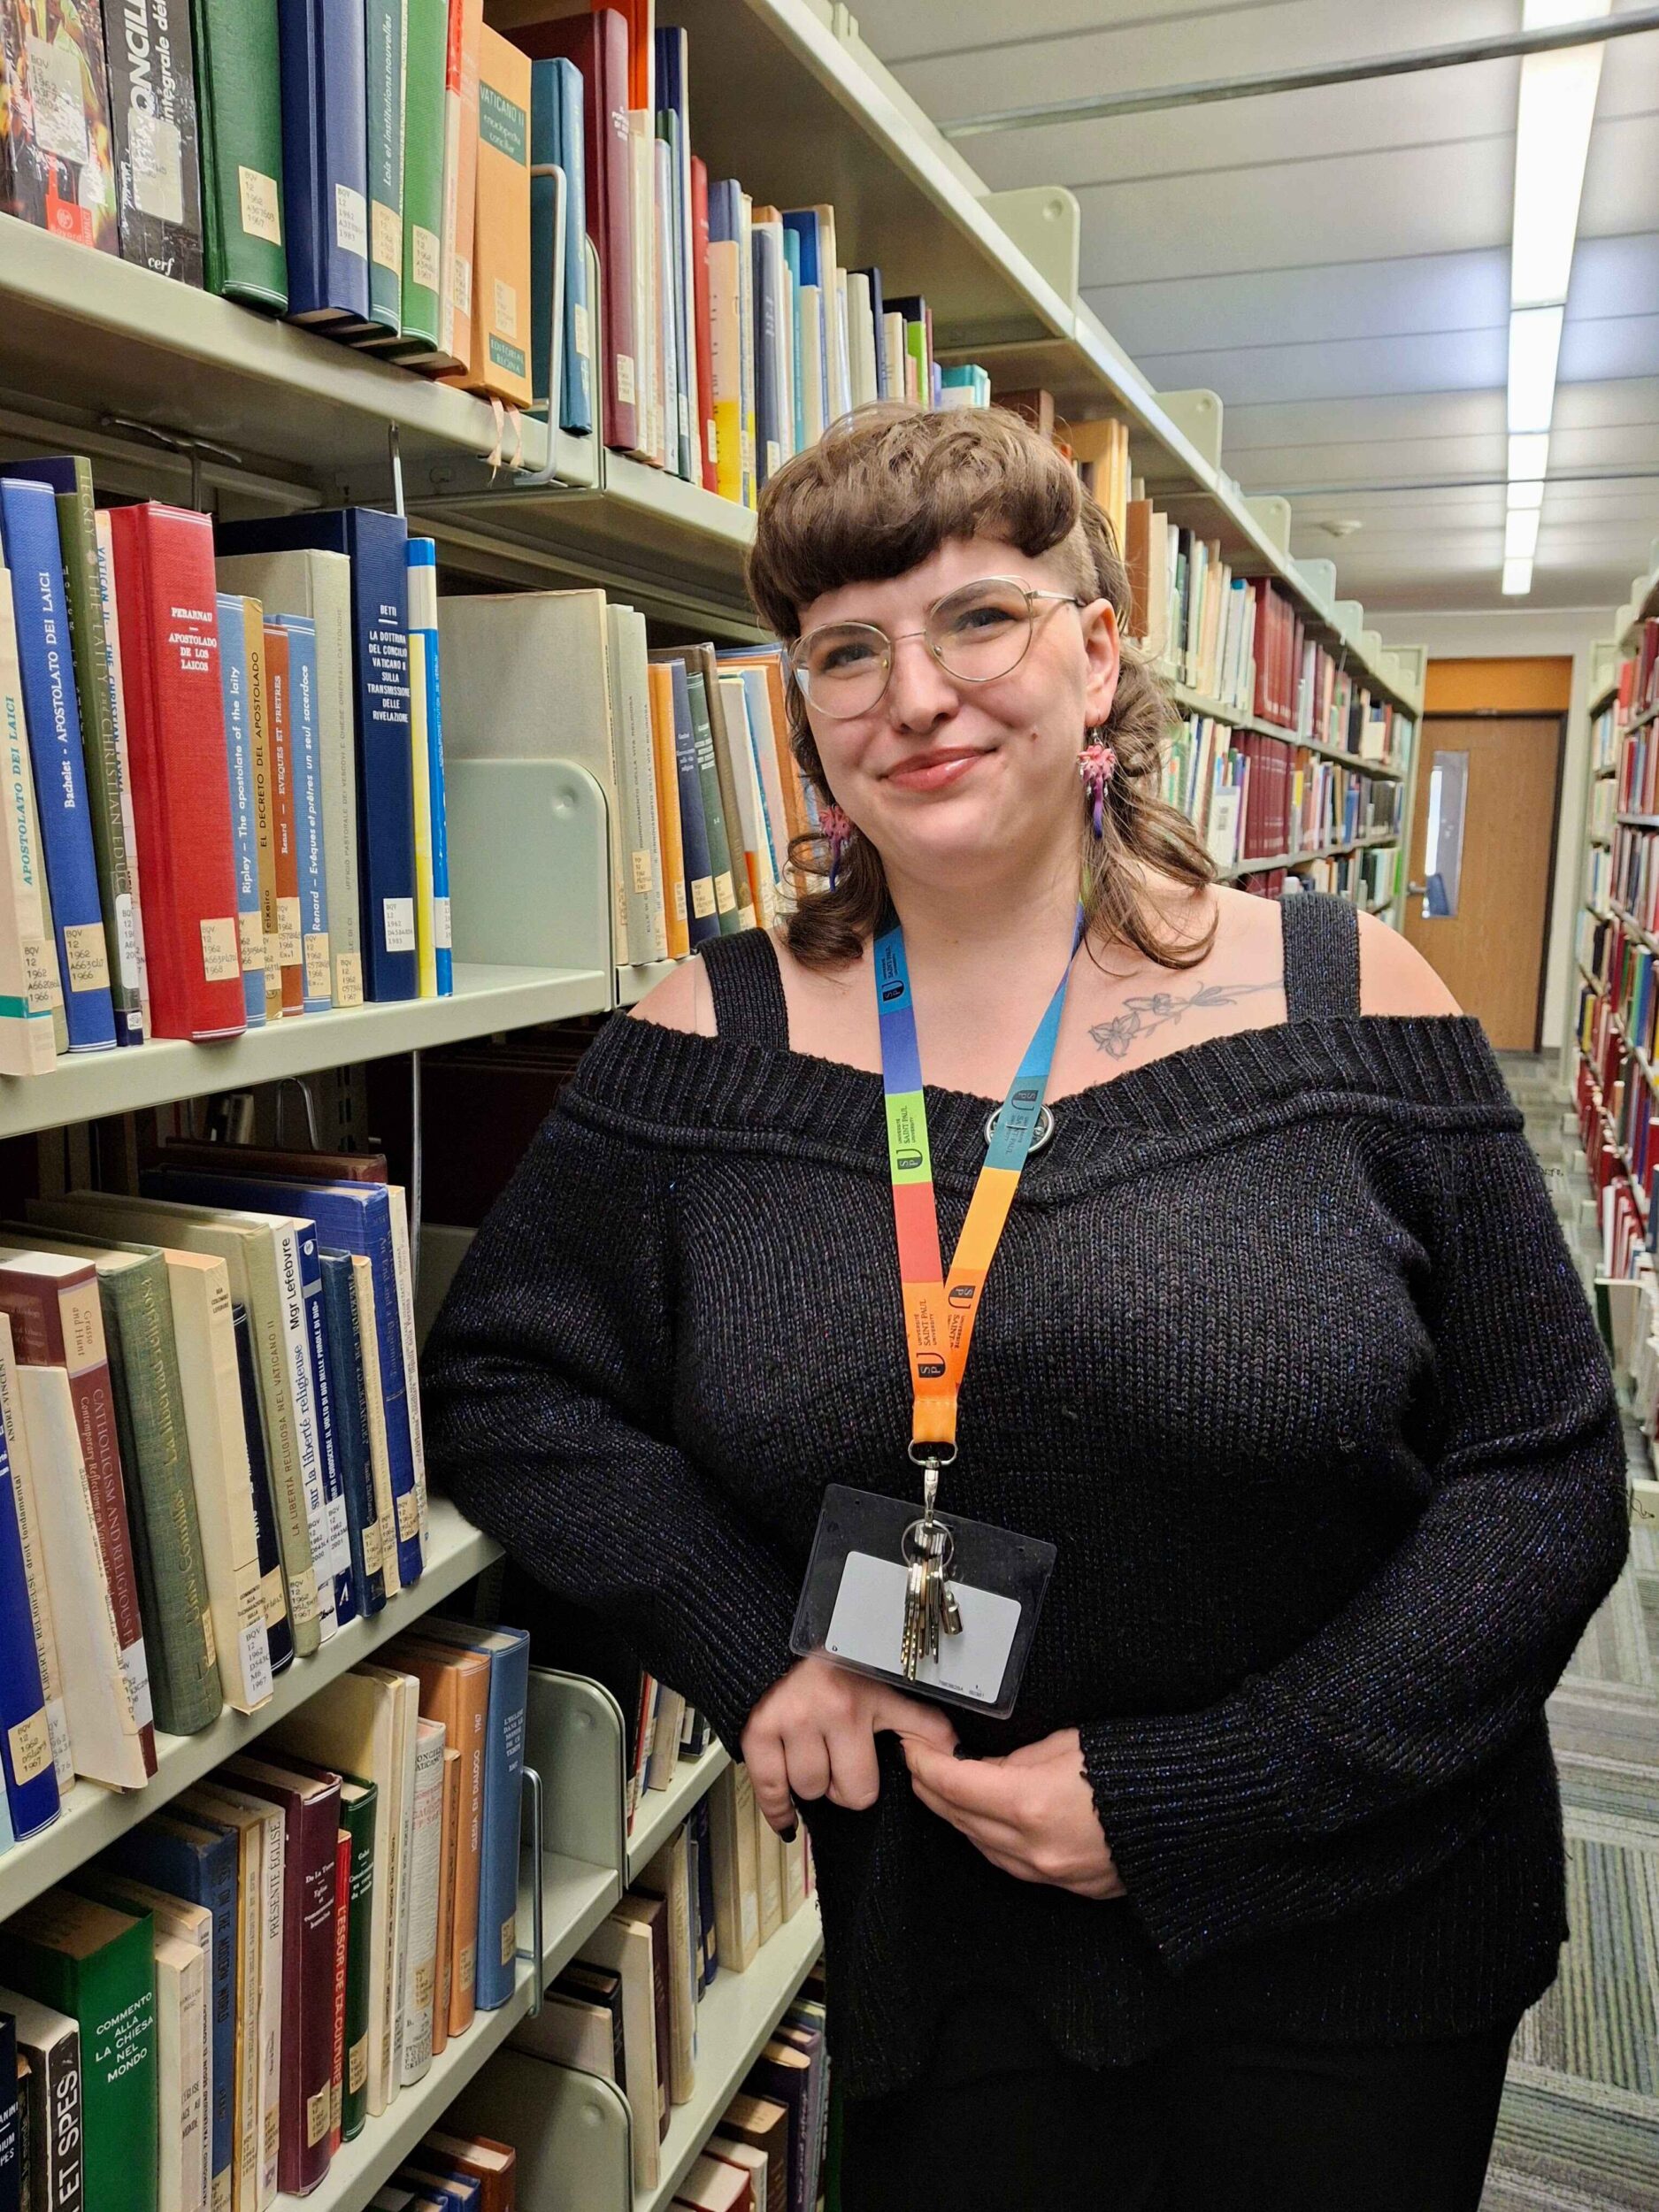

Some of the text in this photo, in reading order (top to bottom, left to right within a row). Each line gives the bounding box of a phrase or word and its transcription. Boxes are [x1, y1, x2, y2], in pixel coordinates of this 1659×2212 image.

[383, 13, 392, 186] Lois et institutions nouvelles
[480, 85, 517, 122] VATICANO
[148, 257, 175, 276] cerf
[39, 572, 54, 613] LAICI
[88, 575, 102, 611] THE
[380, 604, 396, 617] BETTI
[46, 618, 57, 645] DEI
[169, 634, 217, 648] APOSTOLADO
[370, 631, 406, 644] LA DOTTRINA
[91, 625, 109, 684] LAITY
[180, 648, 209, 658] DE LOS
[181, 662, 209, 672] LAICOS
[369, 643, 407, 657] DEL CONCILIO
[373, 657, 401, 670] VATICANO
[251, 651, 263, 738] APOSTOLADO
[301, 665, 311, 722] sacerdoce
[367, 683, 411, 696] TRANSMISSIONE
[381, 672, 399, 682] SULLA
[48, 651, 68, 742] APOSTOLATO
[382, 698, 400, 709] DELLE
[276, 727, 283, 742] ET
[373, 710, 409, 723] RIVELAZIONE
[102, 715, 122, 825] CHRISTIAN
[230, 667, 252, 894] Ripley The apostolate of the laity
[306, 755, 311, 770] un
[6, 696, 33, 886] APOSTOLATO DEI LAICI
[64, 761, 75, 809] Bachelet
[257, 773, 266, 828] DECRETO
[307, 774, 317, 815] prêtres
[310, 814, 316, 826] et
[260, 834, 267, 848] EL
[310, 824, 319, 875] Evêques
[311, 889, 321, 932] Renard
[66, 930, 82, 939] BQV
[27, 969, 47, 978] 1962
[282, 1237, 300, 1331] Mgr Lefebvre
[75, 1328, 85, 1356] Hunt
[84, 1311, 93, 1345] Grasso
[314, 1329, 324, 1358] PAROLE
[949, 1315, 959, 1342] SAINT
[268, 1333, 281, 1386] VATICANO
[276, 1393, 285, 1412] NEL
[319, 1382, 327, 1394] DIO
[295, 1344, 320, 1510] sur la liberté religieuse
[321, 1405, 331, 1429] VOLTO
[81, 1396, 95, 1461] Contemporary
[89, 1462, 100, 1510] Reflections
[92, 1388, 116, 1502] CATHOLICISM
[279, 1417, 293, 1472] RELIGIOSA
[325, 1440, 335, 1478] CONOSCERE
[14, 1475, 28, 1540] fondamental
[107, 1506, 122, 1543] AND
[293, 1523, 300, 1536] LA
[113, 1544, 134, 1628] RELIGIOUS
[27, 1572, 43, 1640] RELIGIEUSE
[246, 1626, 261, 1640] BQV
[249, 1647, 264, 1661] 1962
[472, 1798, 479, 1811] EN
[269, 1819, 281, 1939] PRÉSENTE ÉGLISE
[333, 1905, 347, 2085] L'ESSOR DE LA CULTURE
[96, 1992, 152, 2035] COMMENTO
[114, 2016, 139, 2038] ALLA
[96, 2016, 154, 2062] LA CHIESA
[117, 2045, 139, 2062] NEL
[107, 2047, 148, 2083] MONDO
[58, 2070, 80, 2205] ET SPES
